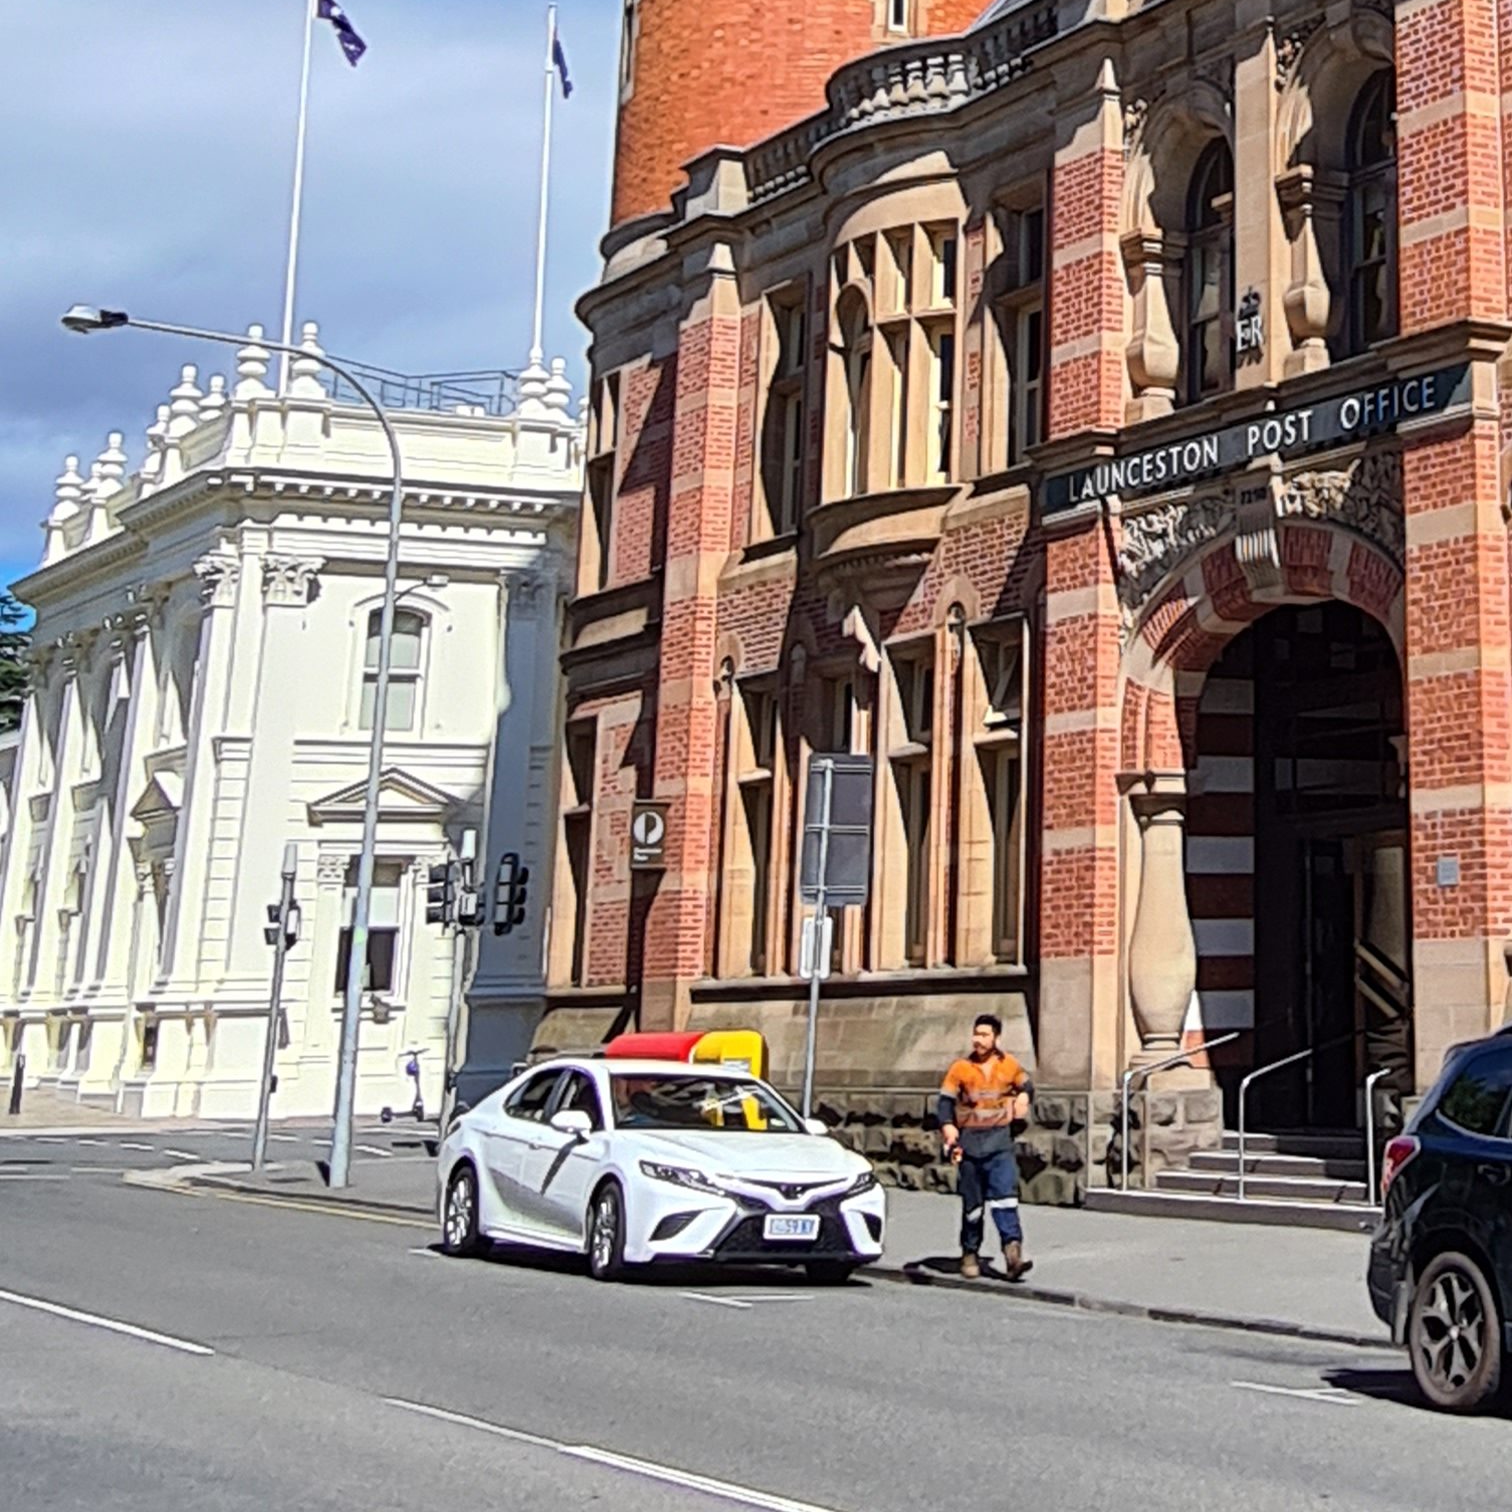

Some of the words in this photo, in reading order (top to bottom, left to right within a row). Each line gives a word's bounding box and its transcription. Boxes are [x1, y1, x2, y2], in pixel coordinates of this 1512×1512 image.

[1069, 435, 1218, 502] LAUNCESTON
[1247, 410, 1313, 456] POST
[1340, 376, 1435, 430] OFFICE
